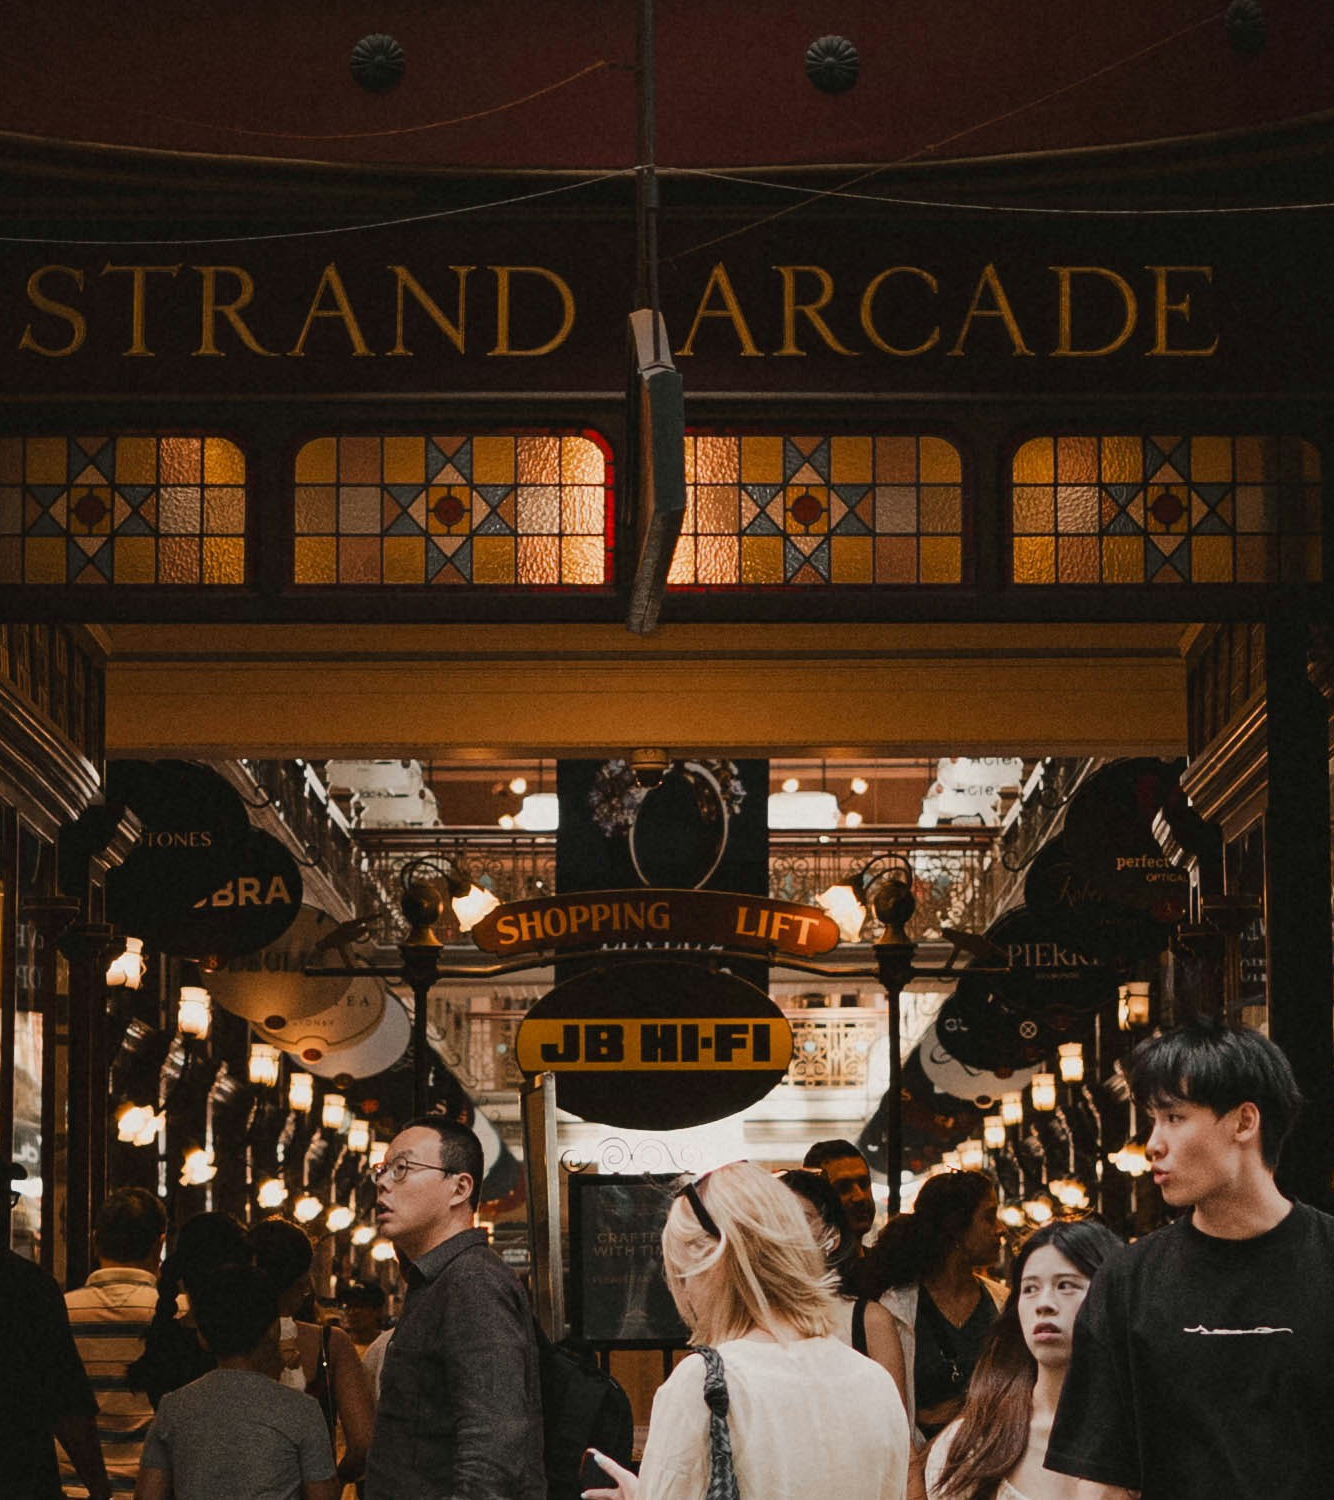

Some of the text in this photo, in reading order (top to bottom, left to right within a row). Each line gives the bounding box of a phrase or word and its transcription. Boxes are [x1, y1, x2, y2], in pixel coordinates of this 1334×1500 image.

[19, 262, 1220, 358] STRAND ARCADE
[192, 875, 292, 908] BRA
[495, 900, 820, 948] SHOPPING LIFT
[541, 1024, 771, 1063] JB HI-FI
[593, 1245, 636, 1257] WITH
